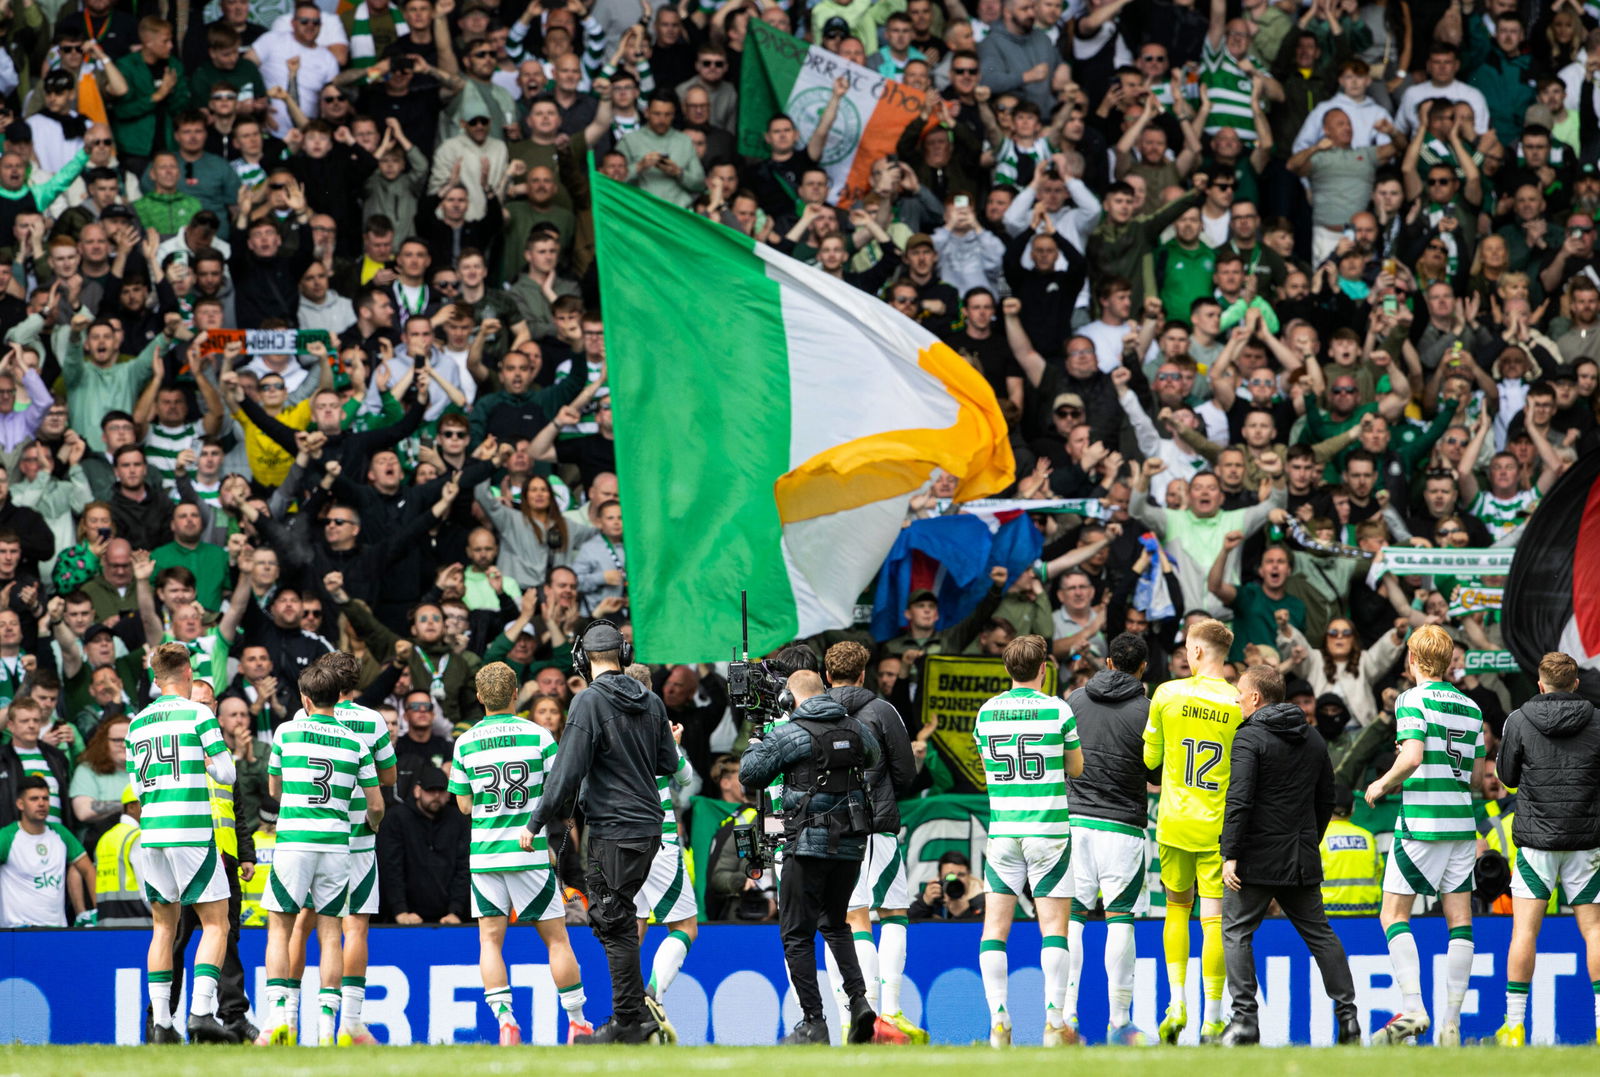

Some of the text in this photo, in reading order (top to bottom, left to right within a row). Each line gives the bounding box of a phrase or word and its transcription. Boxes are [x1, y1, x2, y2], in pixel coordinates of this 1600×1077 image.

[142, 711, 171, 727] KENNY
[992, 708, 1039, 721] RALSTON
[1182, 705, 1230, 724] SINISALO
[303, 731, 342, 748] TAYLOR
[480, 735, 517, 751] DAIZEN
[134, 734, 180, 788] 24
[987, 733, 1046, 782] 56
[1446, 728, 1467, 778] 5
[1181, 738, 1223, 791] 12
[308, 757, 334, 804] 3
[474, 760, 530, 813] 38
[1329, 836, 1367, 850] POLICE
[34, 871, 63, 890] sky
